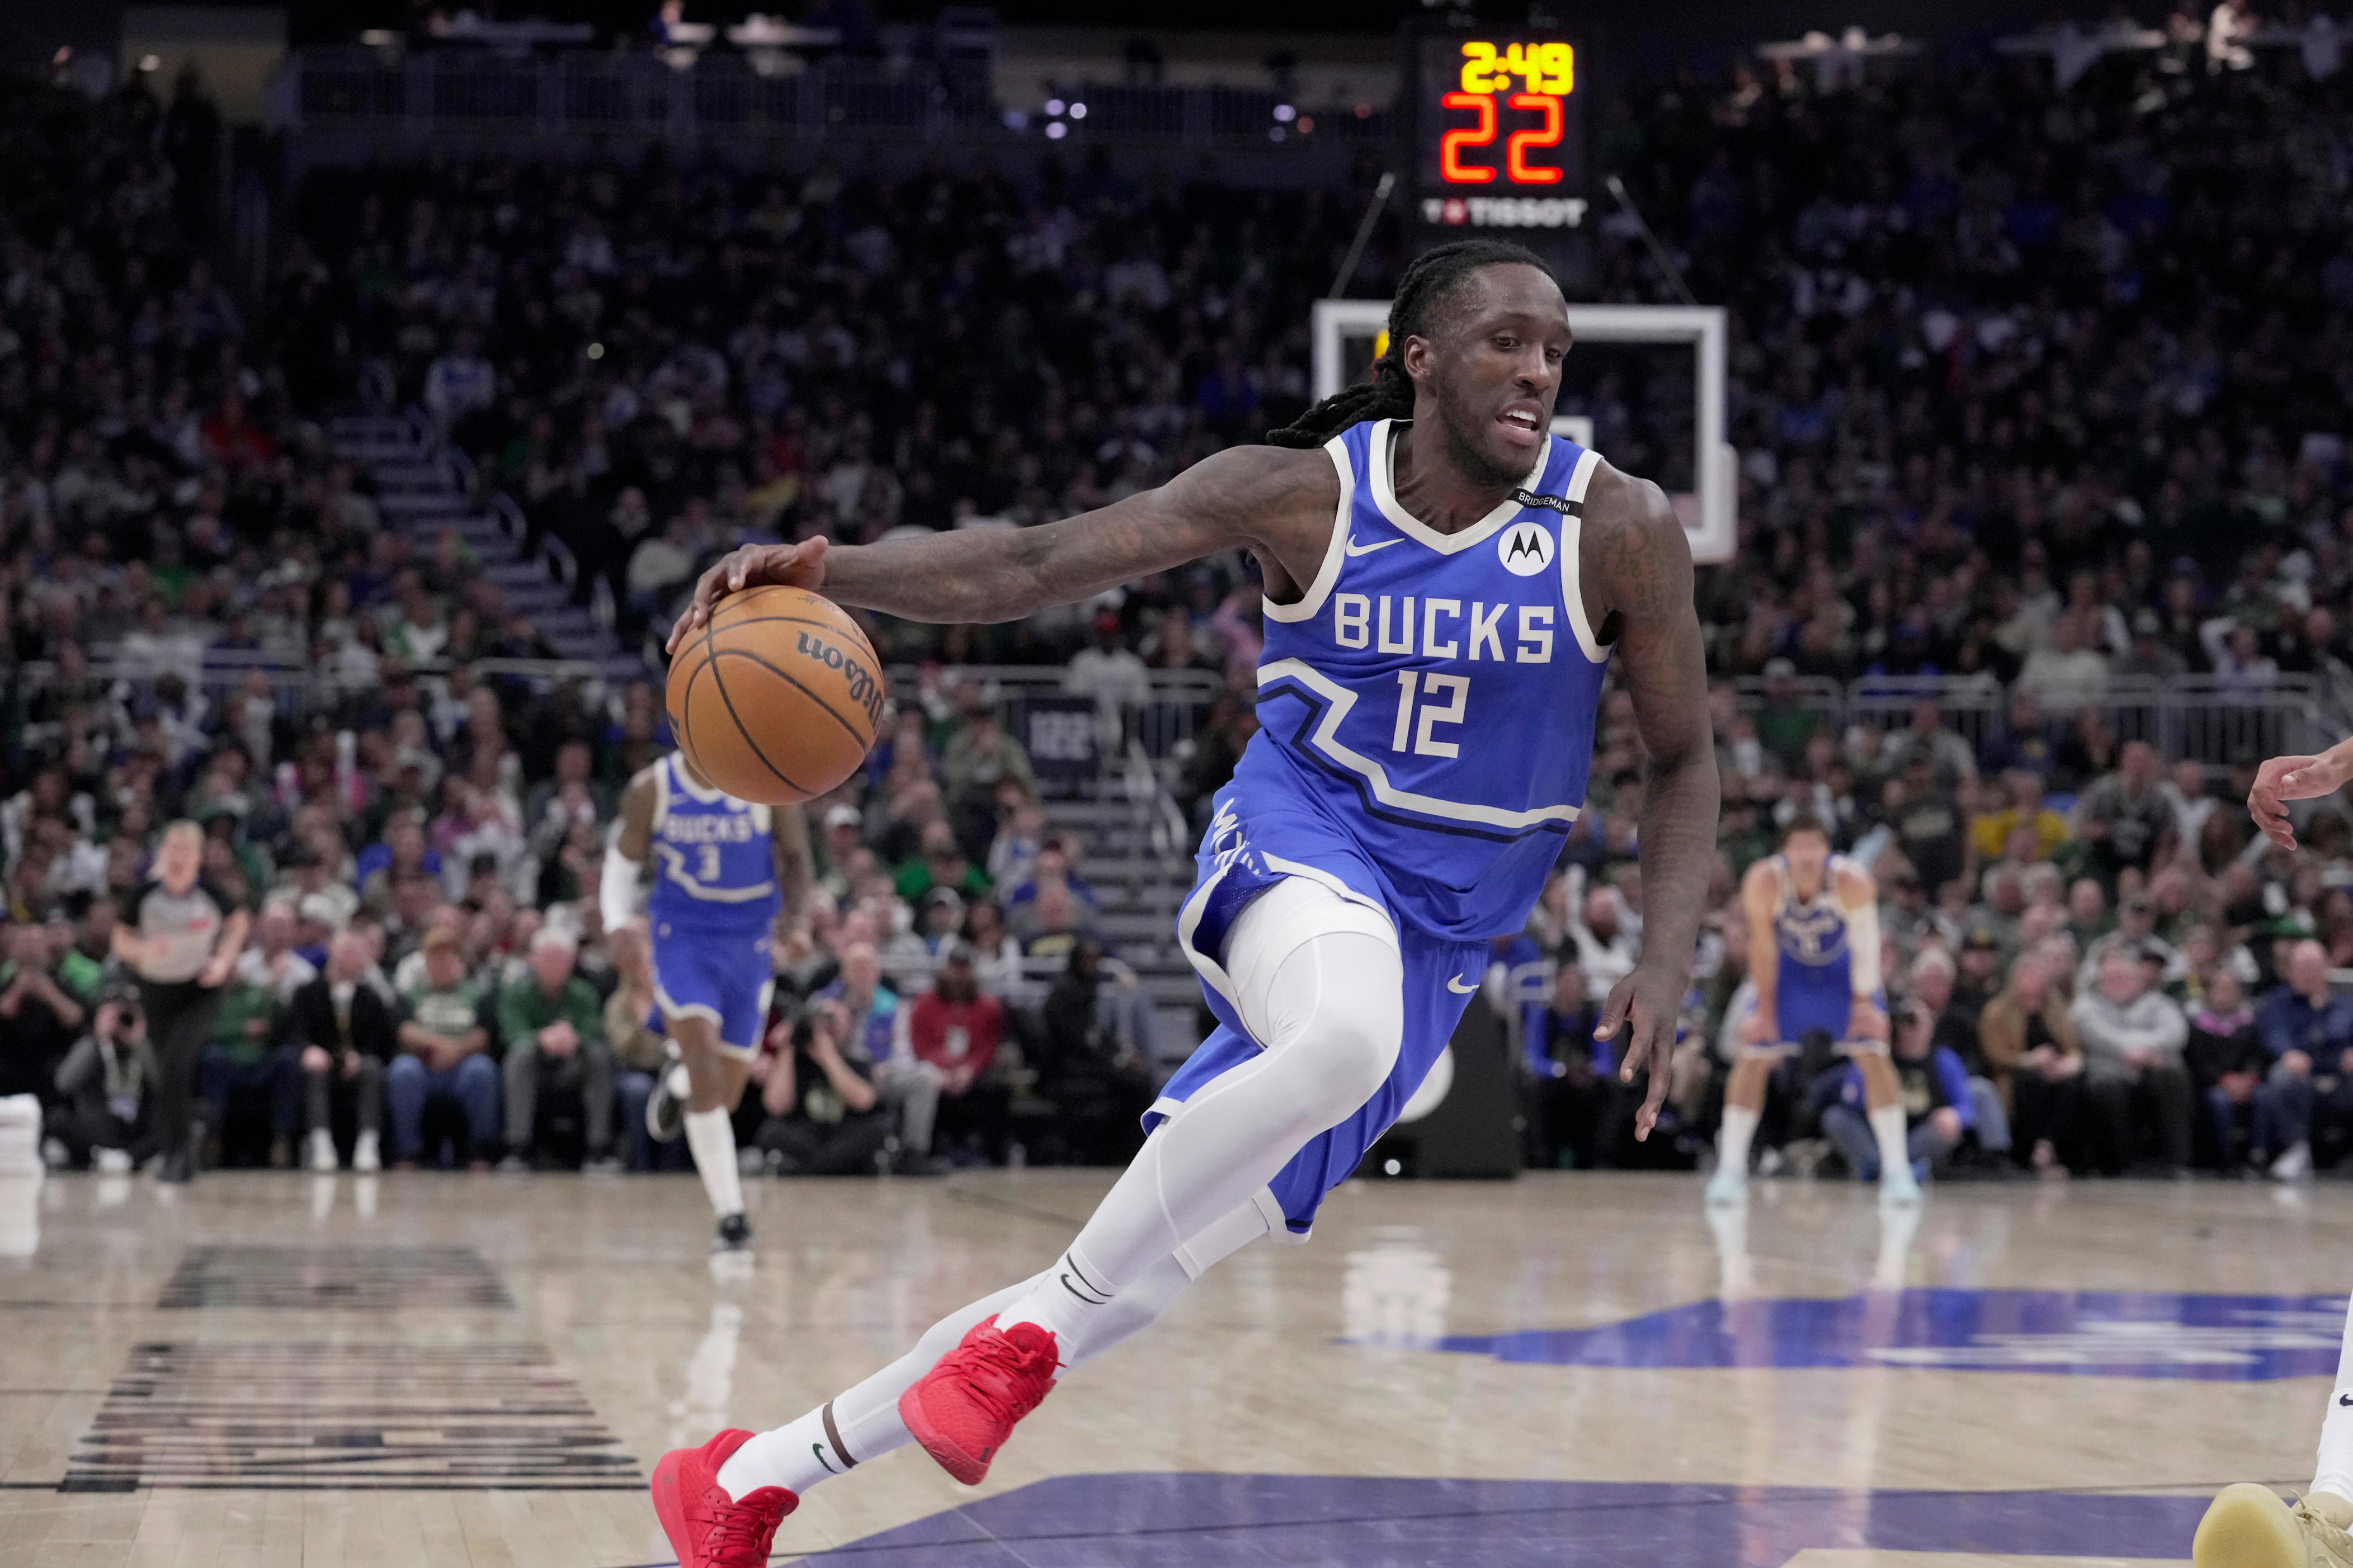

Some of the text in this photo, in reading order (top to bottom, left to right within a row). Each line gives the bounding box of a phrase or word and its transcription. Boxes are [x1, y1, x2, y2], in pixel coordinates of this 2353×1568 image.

[1461, 42, 1573, 95] 2:49
[1441, 92, 1563, 183] 22
[1467, 197, 1587, 228] TISSOT
[1518, 492, 1570, 512] BRIDGEMAN
[1335, 593, 1554, 663] BUCKS
[1392, 670, 1470, 759] 12
[665, 814, 752, 842] BUCKS
[696, 844, 720, 881] 3
